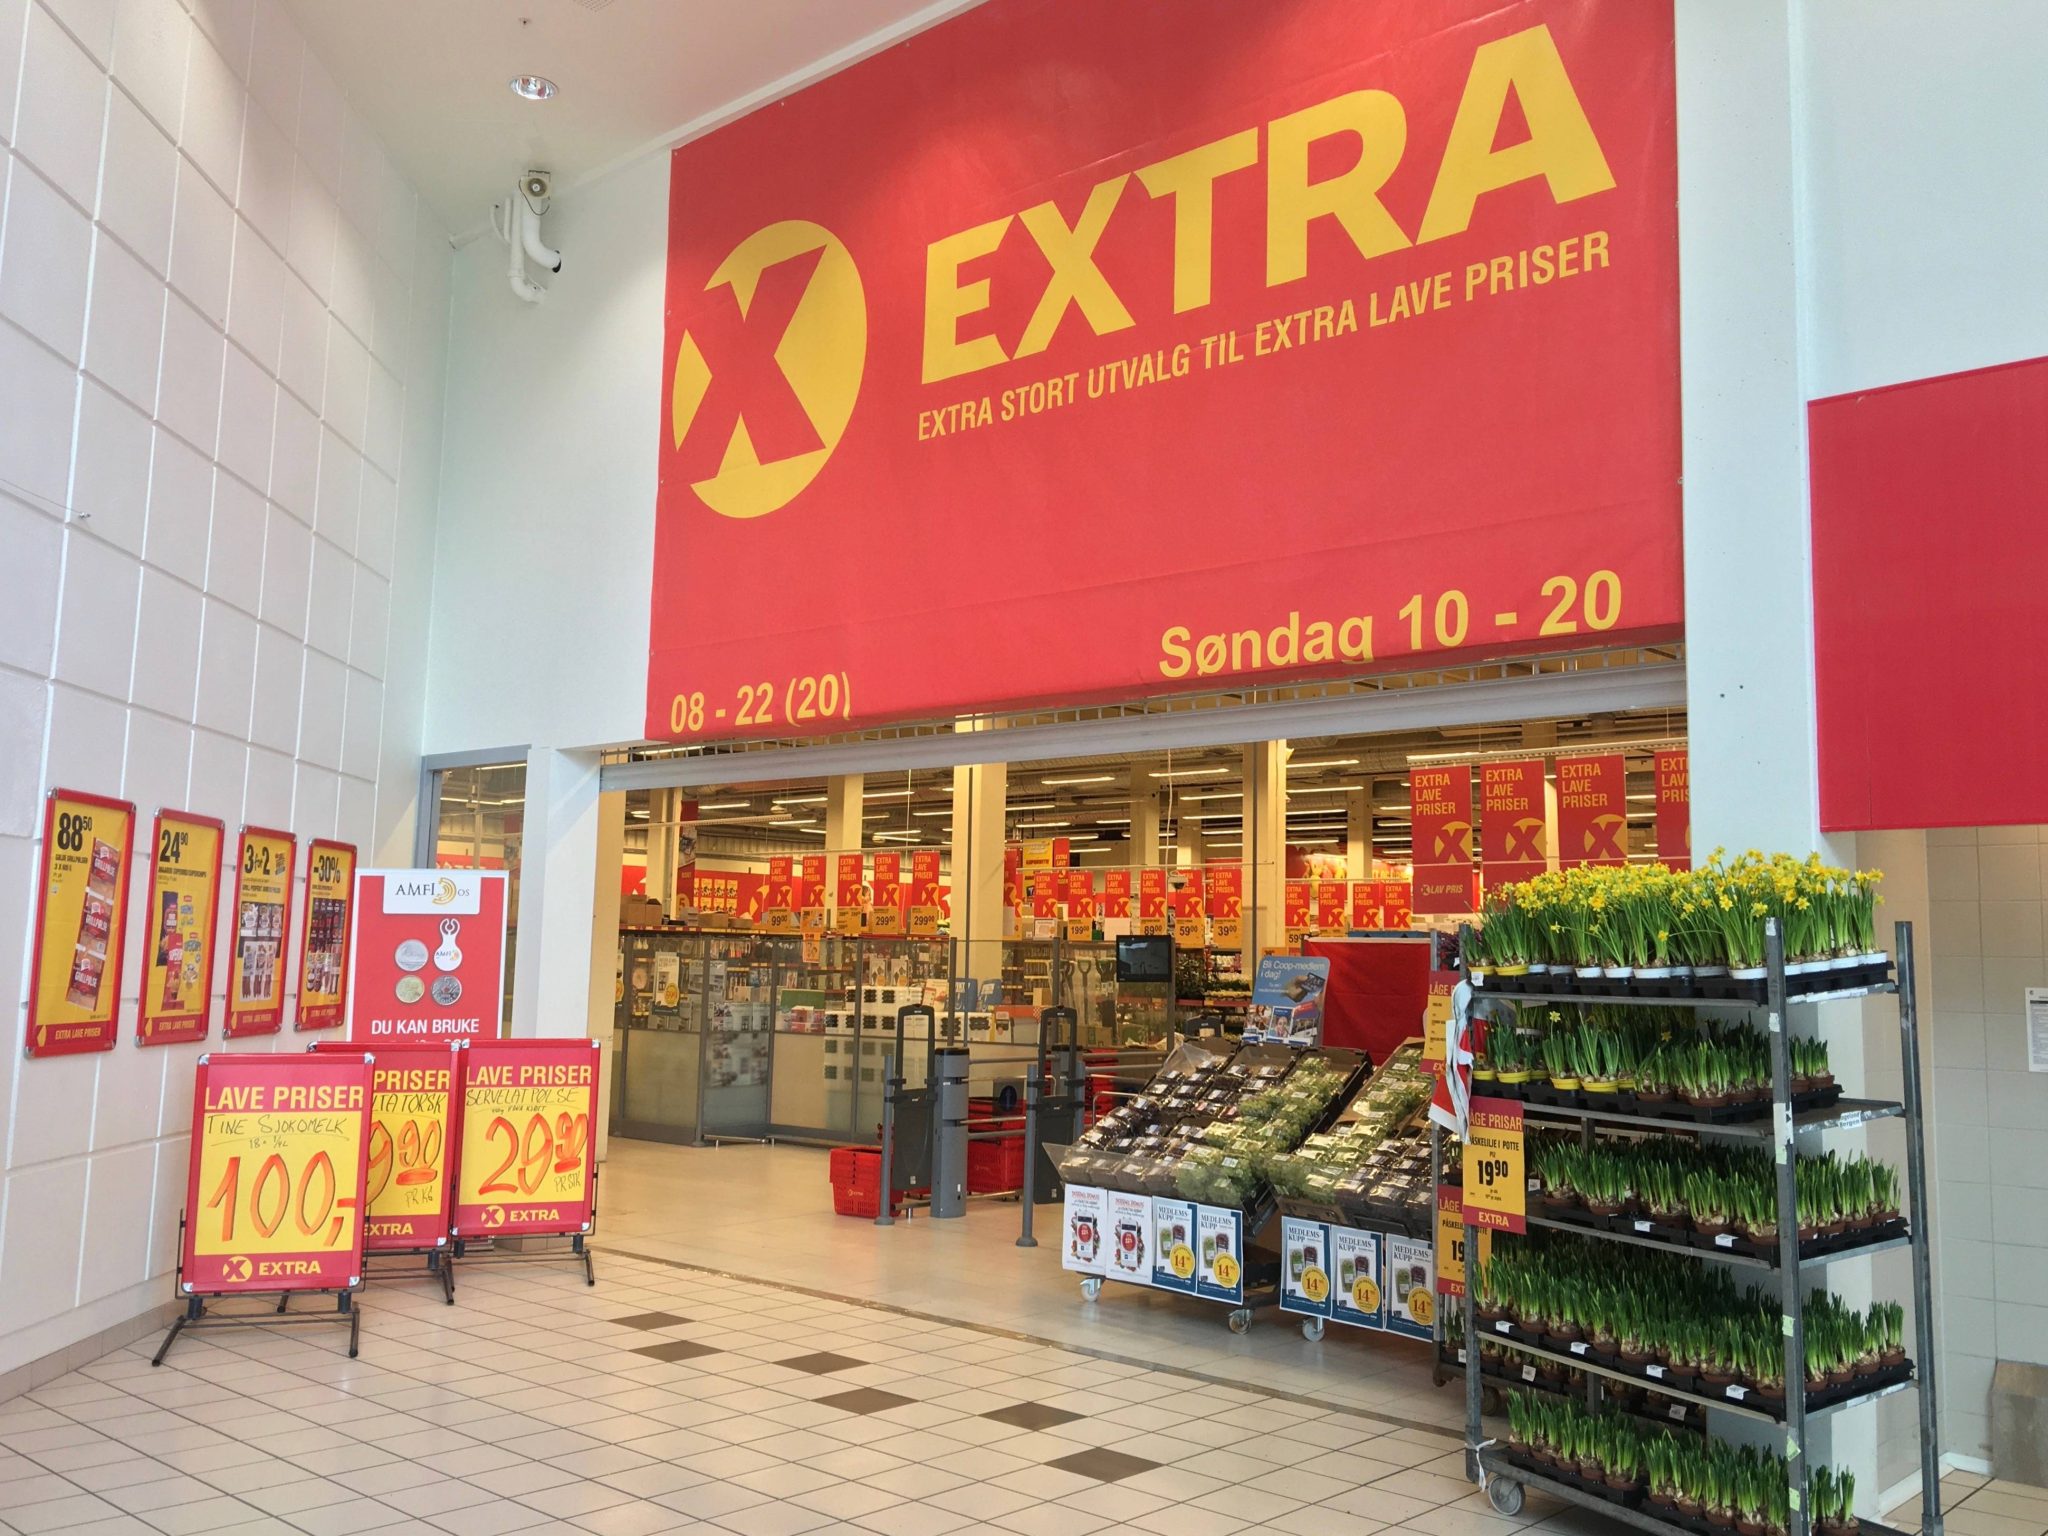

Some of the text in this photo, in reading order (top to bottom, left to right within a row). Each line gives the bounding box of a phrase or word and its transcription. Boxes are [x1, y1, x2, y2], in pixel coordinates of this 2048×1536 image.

[922, 23, 1617, 384] EXTRA
[918, 230, 1610, 441] EXTRA STORT UTVALG TIL EXTRA LAVE PRISER
[1399, 589, 1469, 651] 10
[1539, 569, 1622, 637] 20
[670, 691, 705, 734] 08
[735, 682, 774, 726] 22
[785, 671, 850, 728] (20)
[1561, 763, 1601, 778] EXTRA
[1661, 757, 1688, 771] EXT
[1415, 774, 1451, 788] EXTRA
[1486, 768, 1523, 782] EXTRA
[1486, 783, 1514, 797] LAVE
[1562, 779, 1592, 793] LAVE
[1415, 788, 1442, 802] LAVE
[1563, 793, 1608, 808] PRISER
[1416, 802, 1456, 816] PRISER
[1486, 797, 1529, 812] PRISER
[245, 844, 254, 873] 3
[262, 847, 270, 875] 2
[395, 882, 435, 896] AMFI
[1429, 981, 1448, 995] LÅGE
[372, 1018, 480, 1034] DU KAN BRUKE
[373, 1070, 450, 1091] PRISER
[466, 1065, 592, 1086] LAVE PRISER
[205, 1085, 364, 1111] LAVE PRISER
[207, 1114, 347, 1135] TINE SJOKOMELK
[1470, 1109, 1522, 1131] ÅGE PRISAR
[1470, 1134, 1497, 1148] ÅSKELILJE
[1503, 1140, 1519, 1151] POTTE
[1440, 1197, 1460, 1212] LÅGE
[510, 1209, 560, 1222] EXTRA
[1159, 1214, 1173, 1222] KUPP
[1479, 1211, 1509, 1227] EXTRA
[1201, 1222, 1217, 1231] KUPP
[1289, 1235, 1305, 1243] KUPP
[1339, 1244, 1356, 1253] KUPP
[1451, 1240, 1464, 1262] 19
[1394, 1254, 1412, 1263] KUPP
[258, 1260, 322, 1276] EXTRA
[1450, 1283, 1464, 1294] EXT
